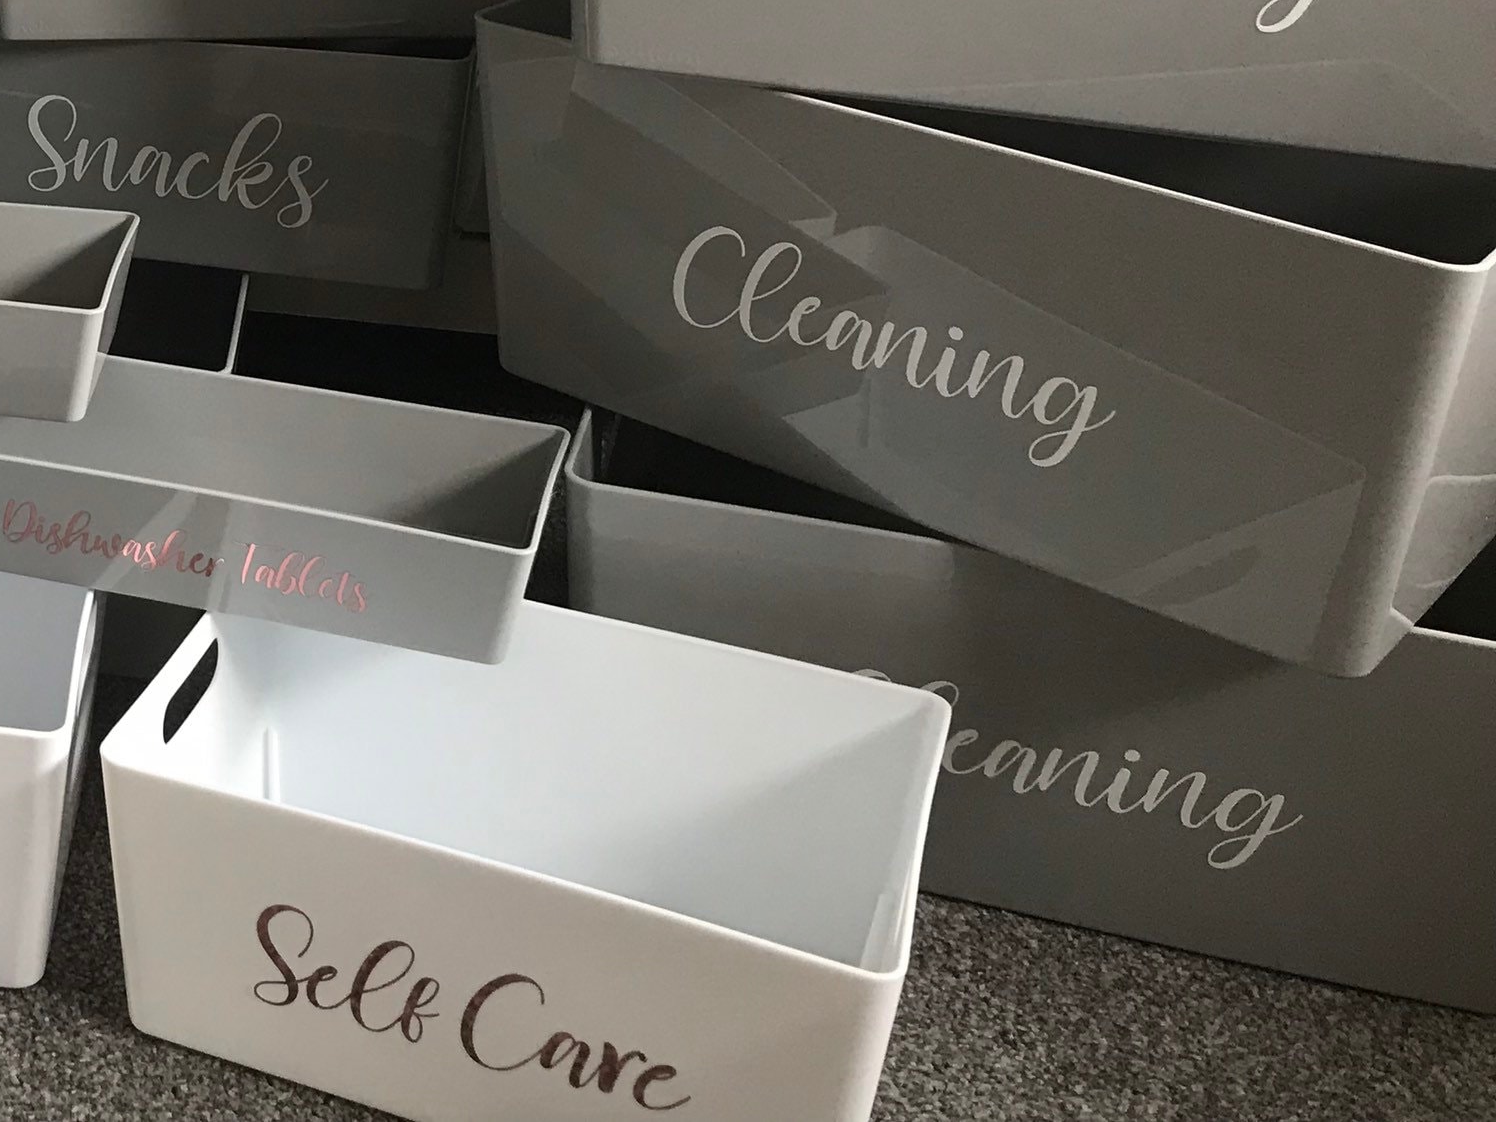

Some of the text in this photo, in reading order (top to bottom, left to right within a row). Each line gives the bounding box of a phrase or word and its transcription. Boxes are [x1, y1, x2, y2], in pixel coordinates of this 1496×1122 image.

[27, 95, 328, 228] Snacks
[671, 225, 1116, 467] Cleaning
[2, 498, 368, 613] Dishwasher Tablets
[851, 668, 1303, 869] eaning
[254, 904, 691, 1110] Self Care
